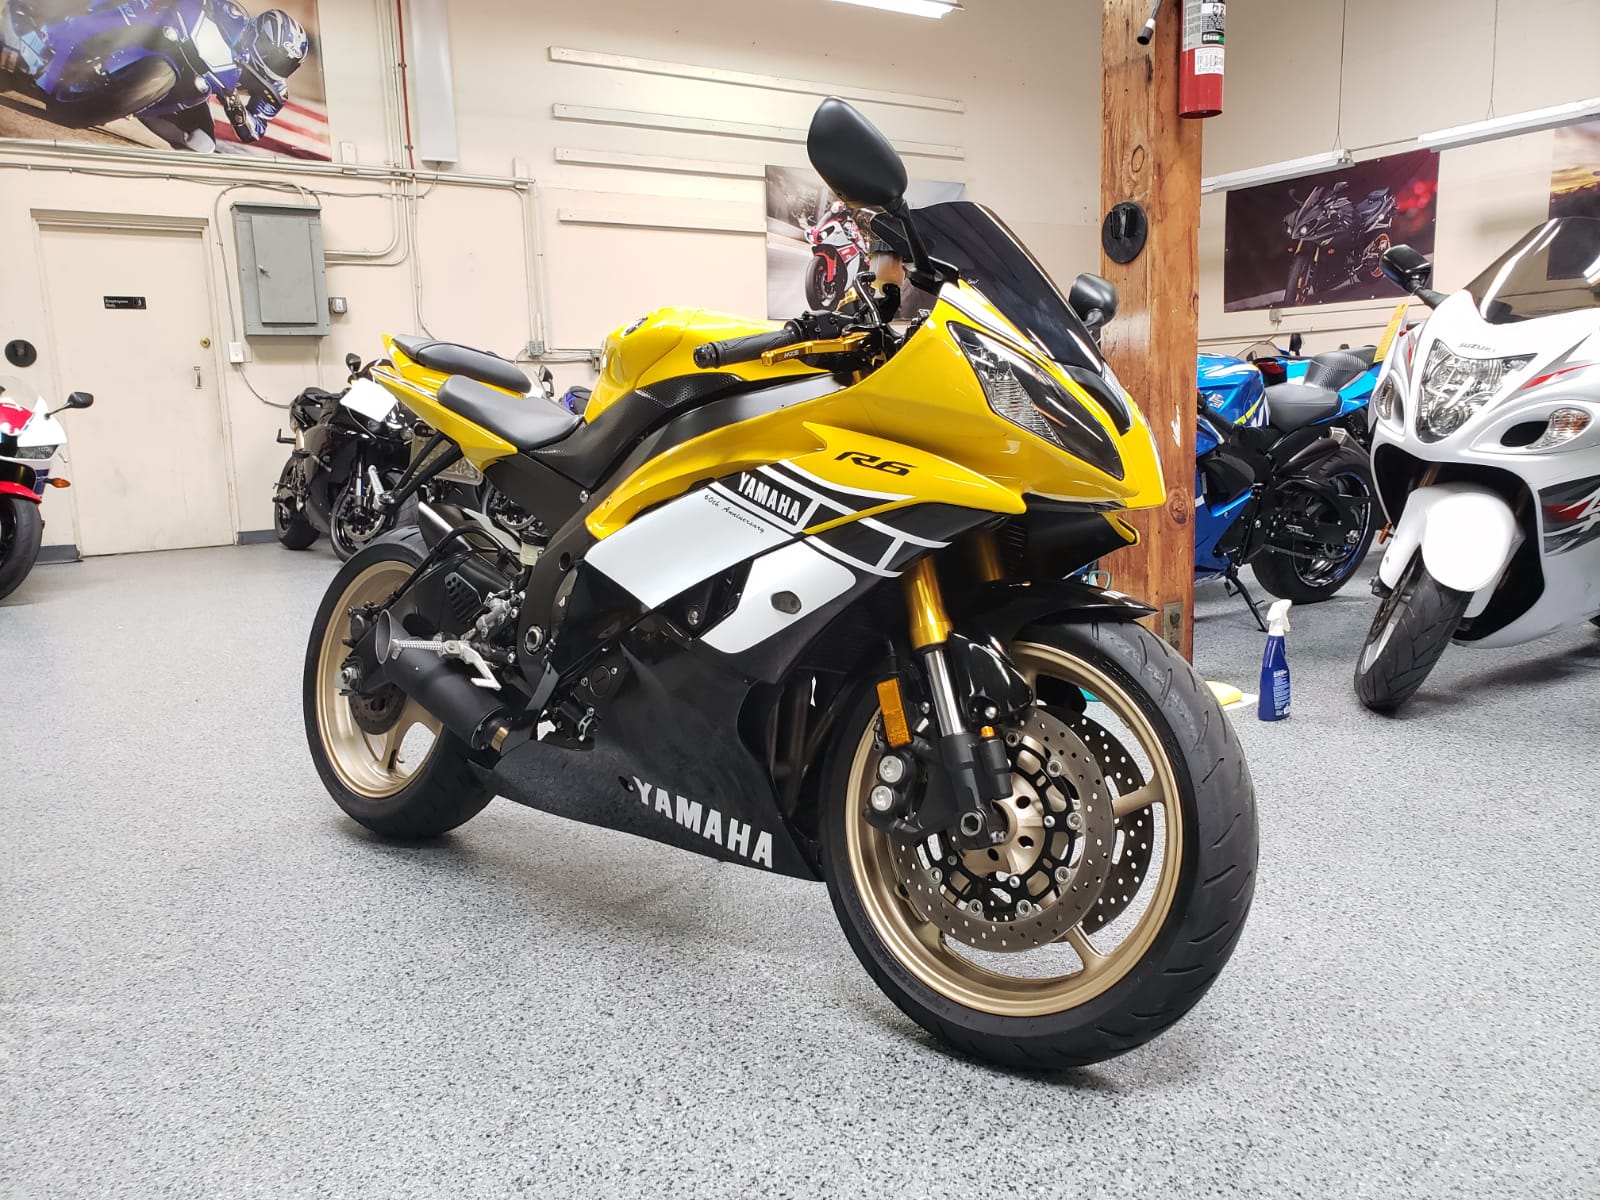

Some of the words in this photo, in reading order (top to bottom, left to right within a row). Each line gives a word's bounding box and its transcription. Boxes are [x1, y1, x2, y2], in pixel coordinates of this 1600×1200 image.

[833, 451, 920, 477] R6
[704, 494, 720, 507] 60th
[738, 471, 801, 522] YAMAHA
[632, 775, 773, 869] YAMAHA
